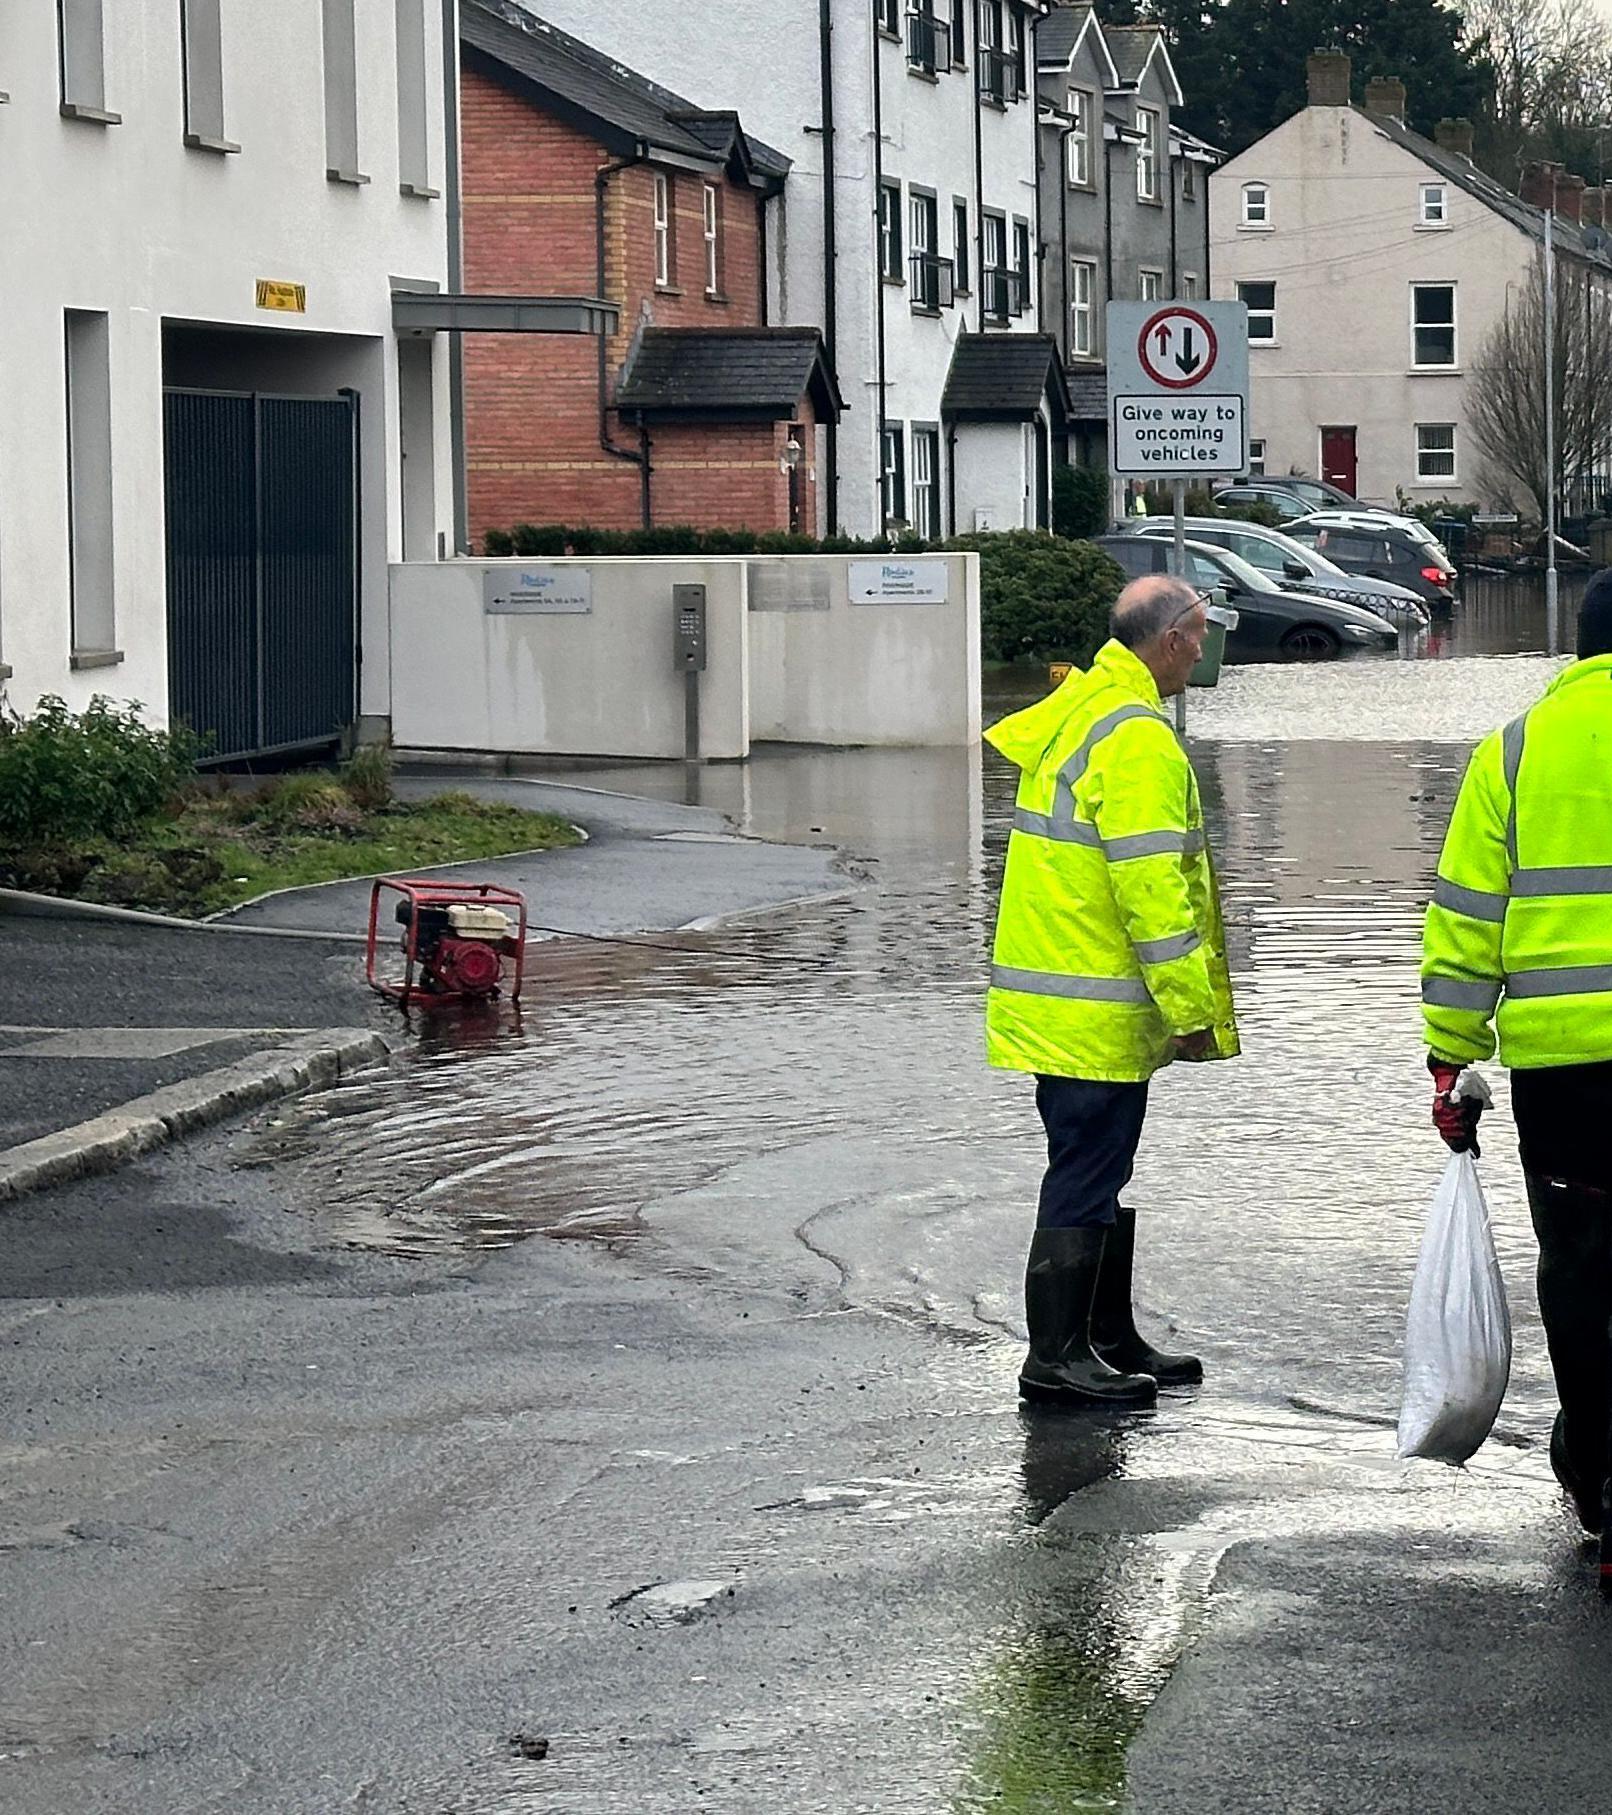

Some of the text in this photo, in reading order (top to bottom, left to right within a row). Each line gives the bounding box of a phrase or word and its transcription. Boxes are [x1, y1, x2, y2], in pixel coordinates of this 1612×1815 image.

[1122, 405, 1235, 422] Give way to
[1135, 425, 1224, 443] oncoming
[1140, 445, 1218, 461] vehicles
